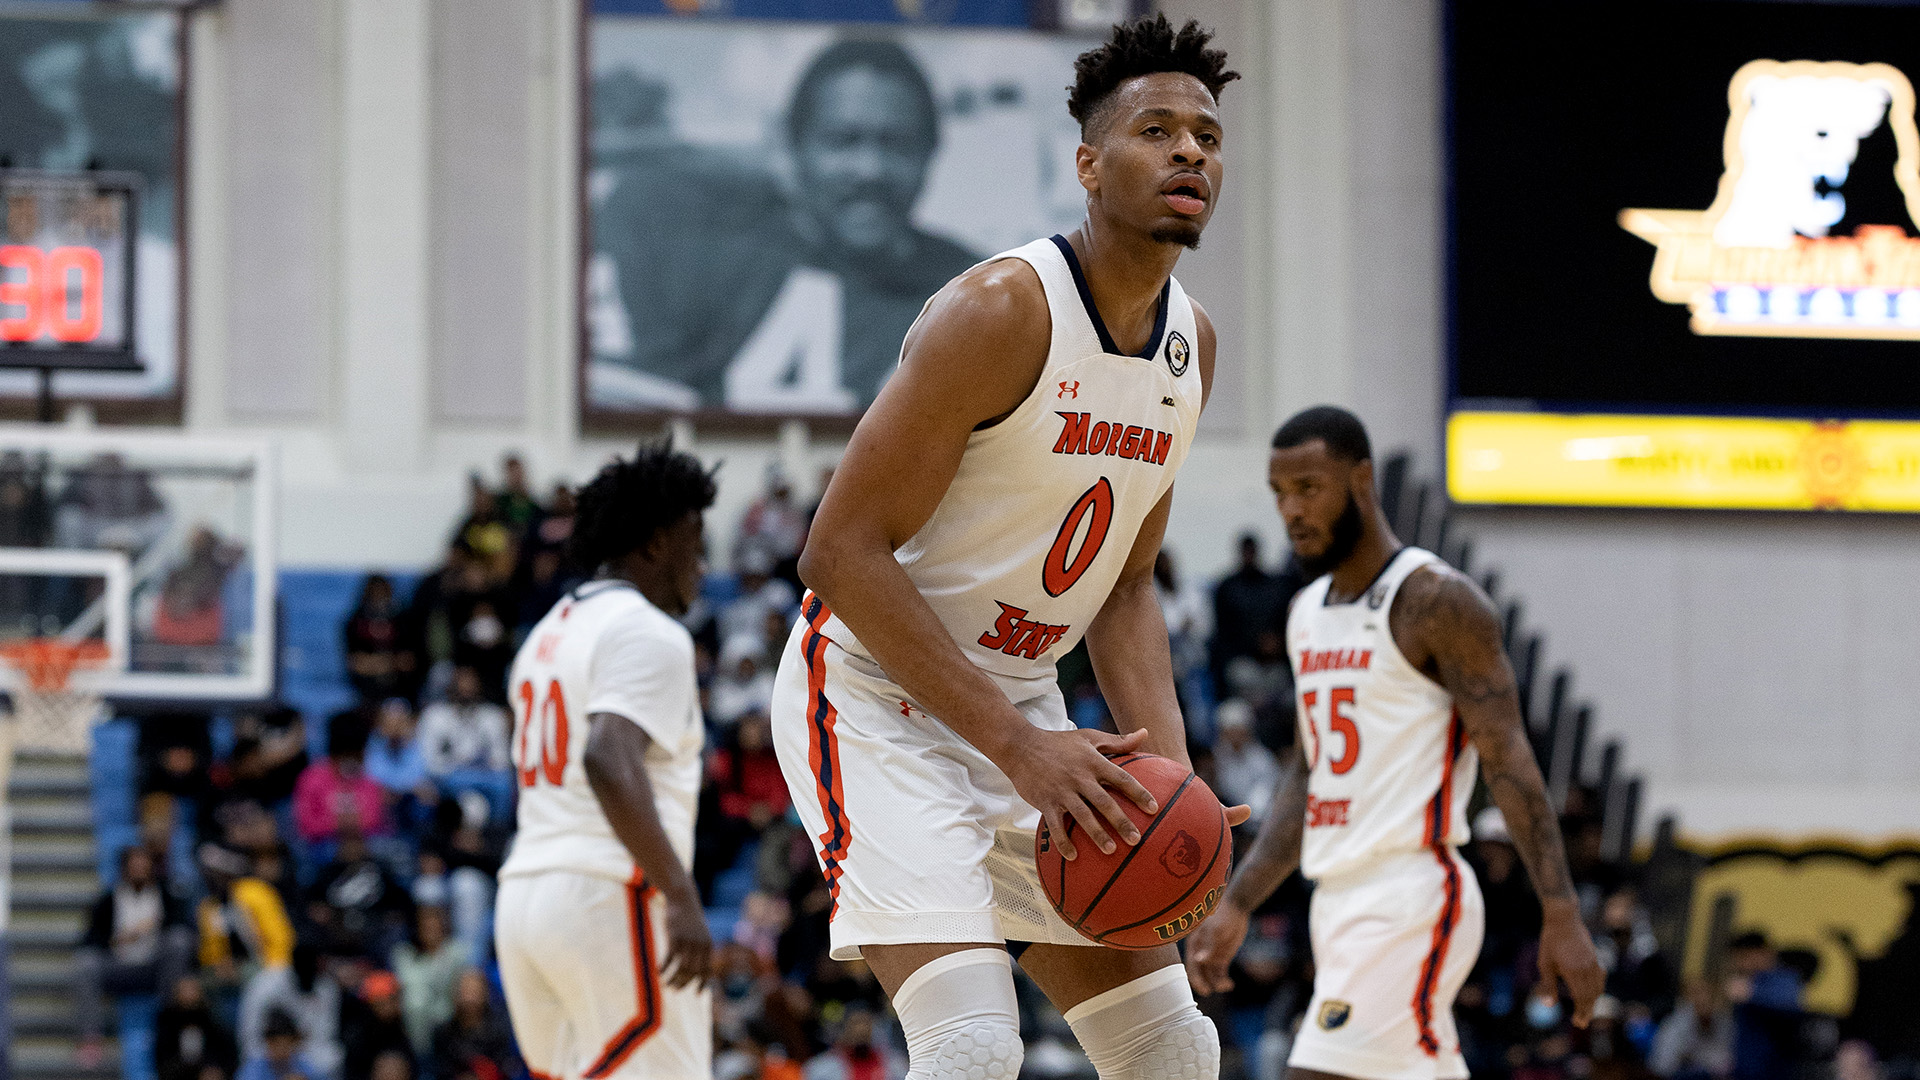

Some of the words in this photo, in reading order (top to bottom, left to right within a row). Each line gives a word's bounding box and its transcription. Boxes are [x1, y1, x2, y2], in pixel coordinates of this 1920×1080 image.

[0, 245, 103, 341] 30
[1053, 411, 1173, 466] MORGAN
[1042, 476, 1115, 598] 0
[519, 679, 569, 787] 20
